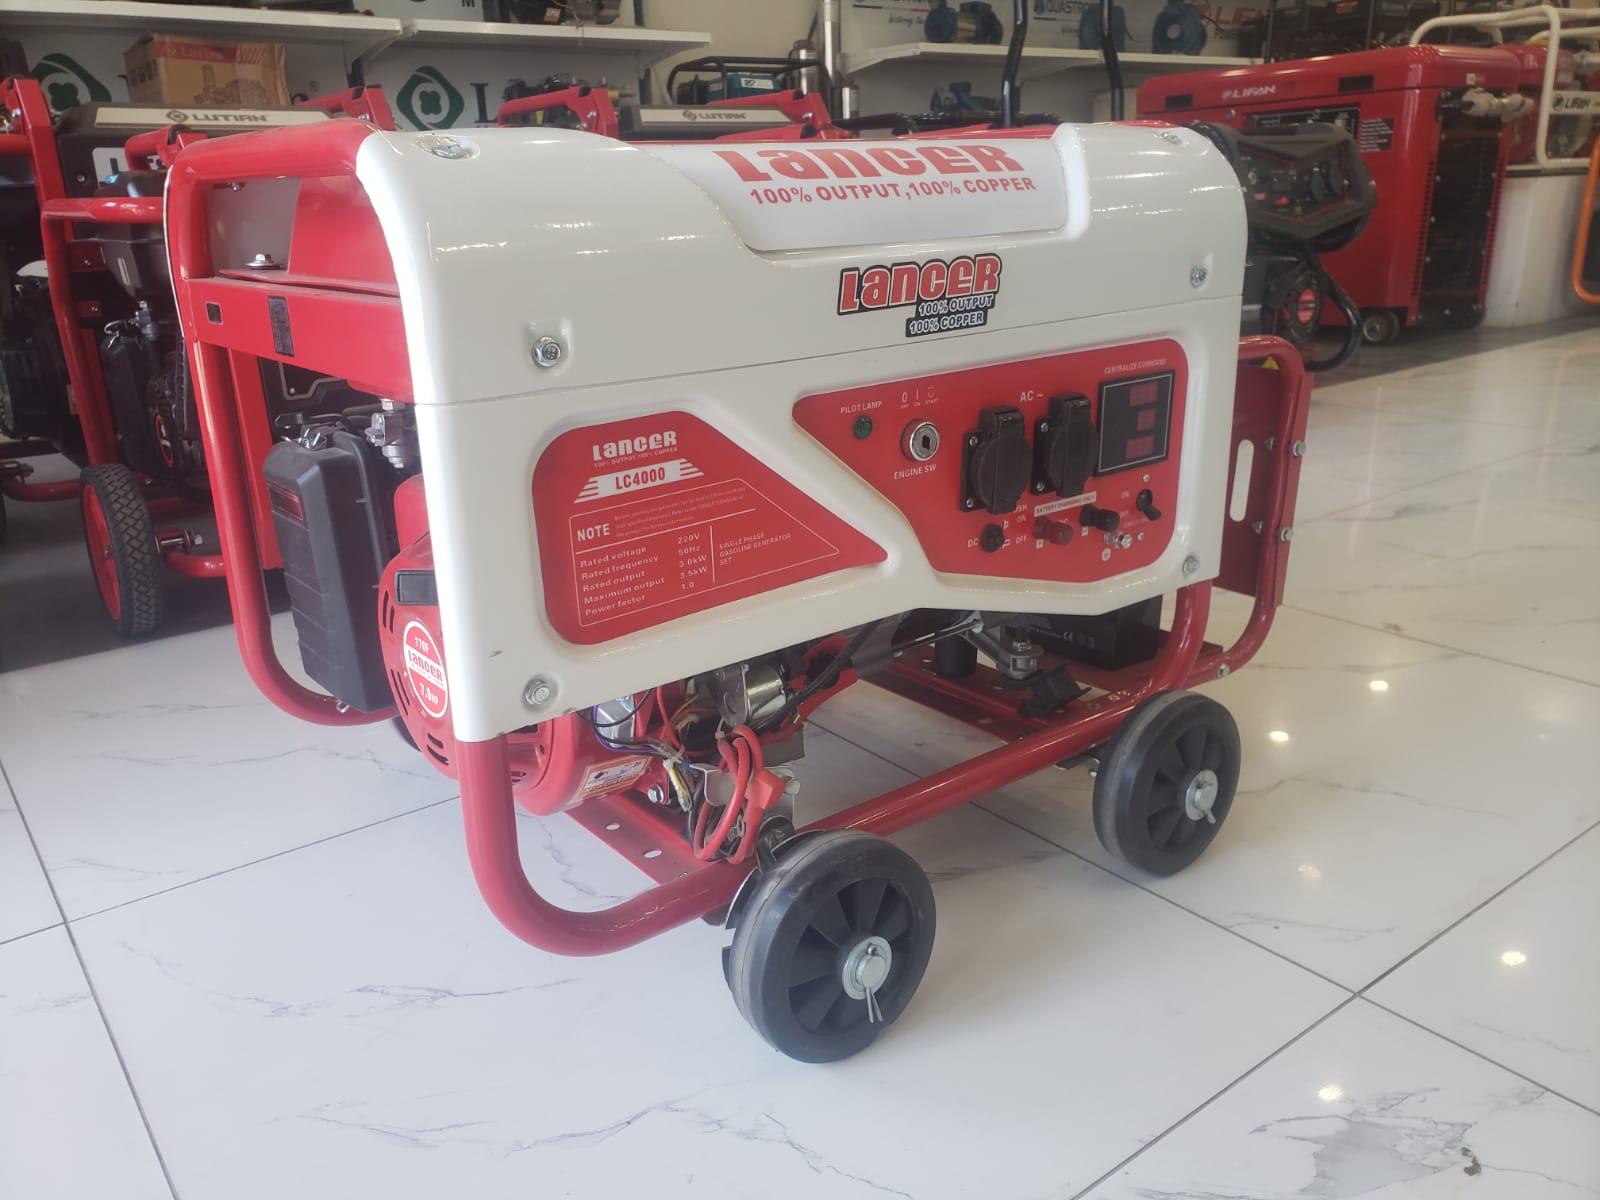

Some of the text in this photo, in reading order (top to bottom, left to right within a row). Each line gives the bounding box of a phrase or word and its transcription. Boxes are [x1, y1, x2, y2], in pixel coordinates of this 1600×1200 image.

[1233, 85, 1276, 98] LIFAN
[191, 113, 267, 122] LUTIAN
[750, 187, 813, 205] 100%
[965, 177, 1037, 194] COPPER
[918, 294, 994, 317] 100% OUTPUT
[909, 311, 984, 335] 100% COPPER
[840, 401, 882, 414] PILOT LAMP
[615, 467, 666, 490] LC4000
[894, 464, 937, 480] ENGINE SW
[577, 523, 610, 542] NOTE
[719, 532, 765, 550] SINGLE PHASE
[580, 533, 700, 569] Rated voltage 220V
[719, 532, 791, 558] GASOLINE GENERATOR
[581, 546, 700, 581] Rated frequency 50Hz
[582, 579, 611, 593] Rated
[613, 570, 646, 585] output
[584, 586, 632, 605] Maximum
[634, 577, 665, 592] output
[585, 603, 616, 617] Power
[618, 594, 646, 608] factor
